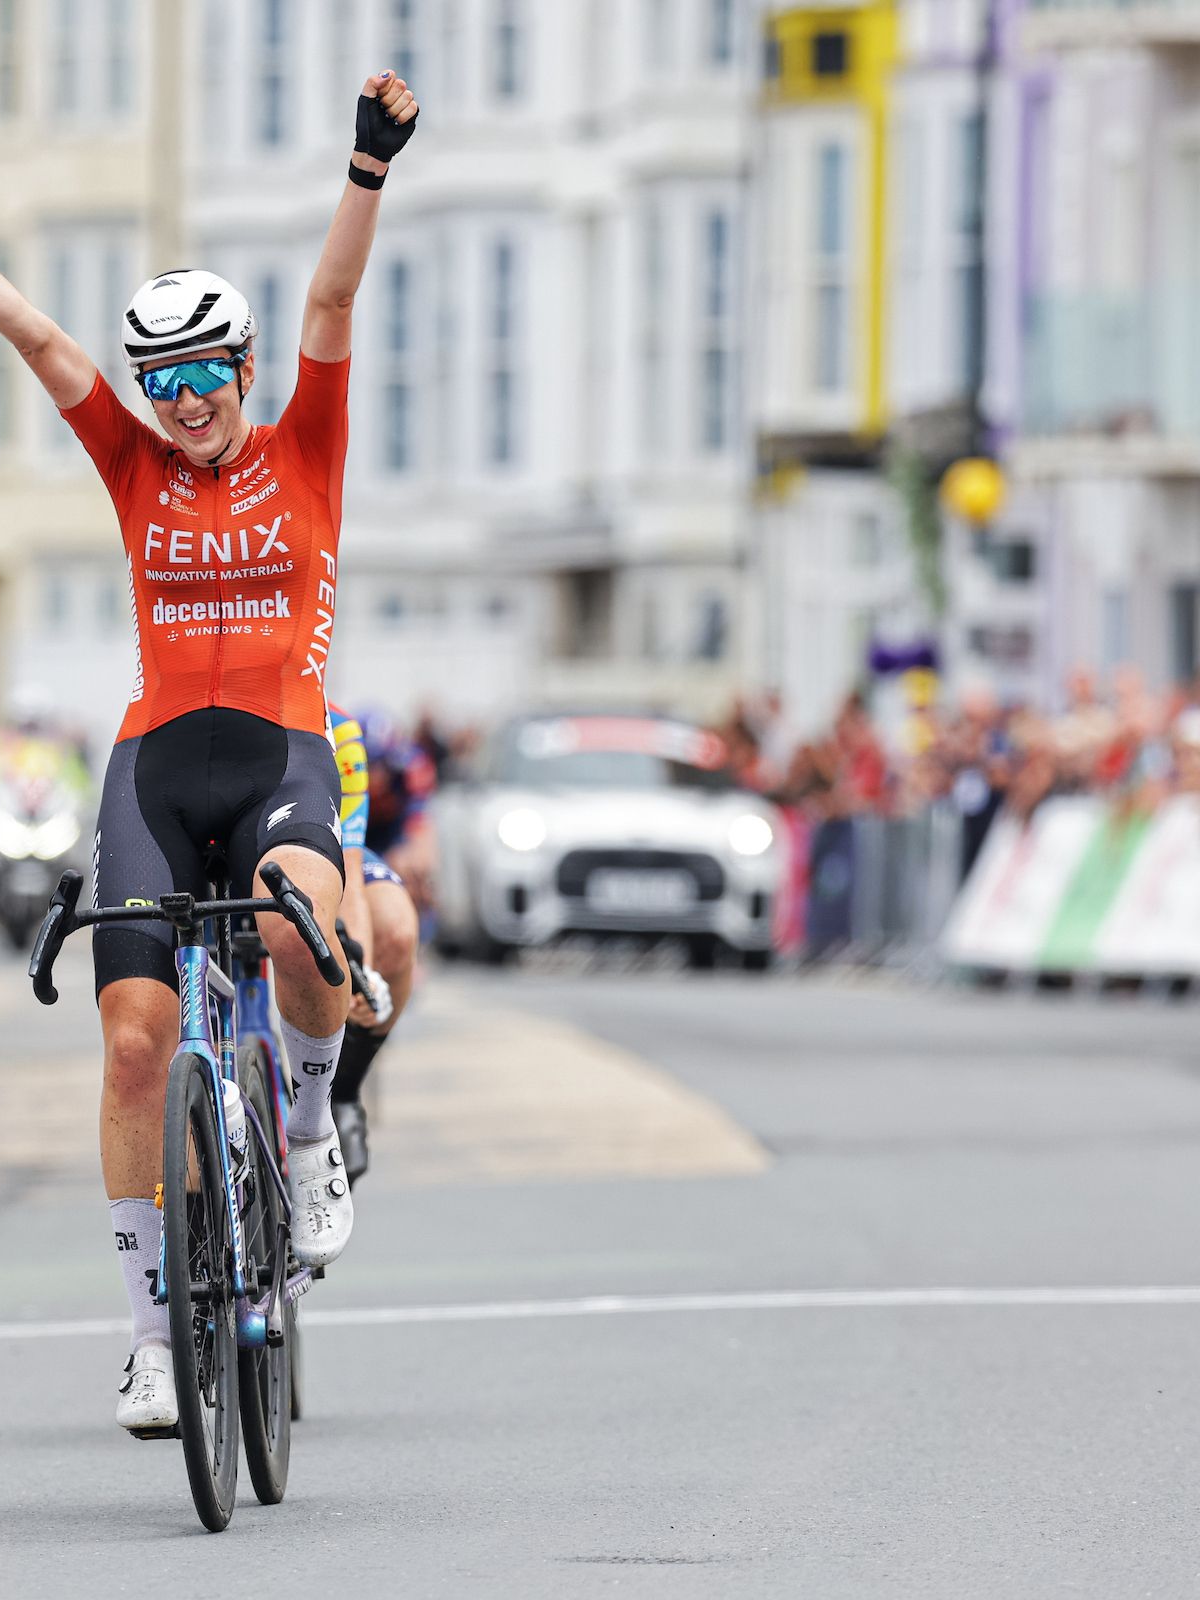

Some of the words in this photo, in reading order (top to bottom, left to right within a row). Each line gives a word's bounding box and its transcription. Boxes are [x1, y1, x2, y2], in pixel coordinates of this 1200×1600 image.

[150, 314, 183, 326] CANYON
[144, 515, 290, 564] FENIX
[145, 568, 217, 582] INNOVATIVE
[220, 559, 294, 581] MATERIALS
[152, 590, 291, 625] deceuninck
[301, 549, 335, 684] FENIX
[184, 625, 253, 637] WINDOWS
